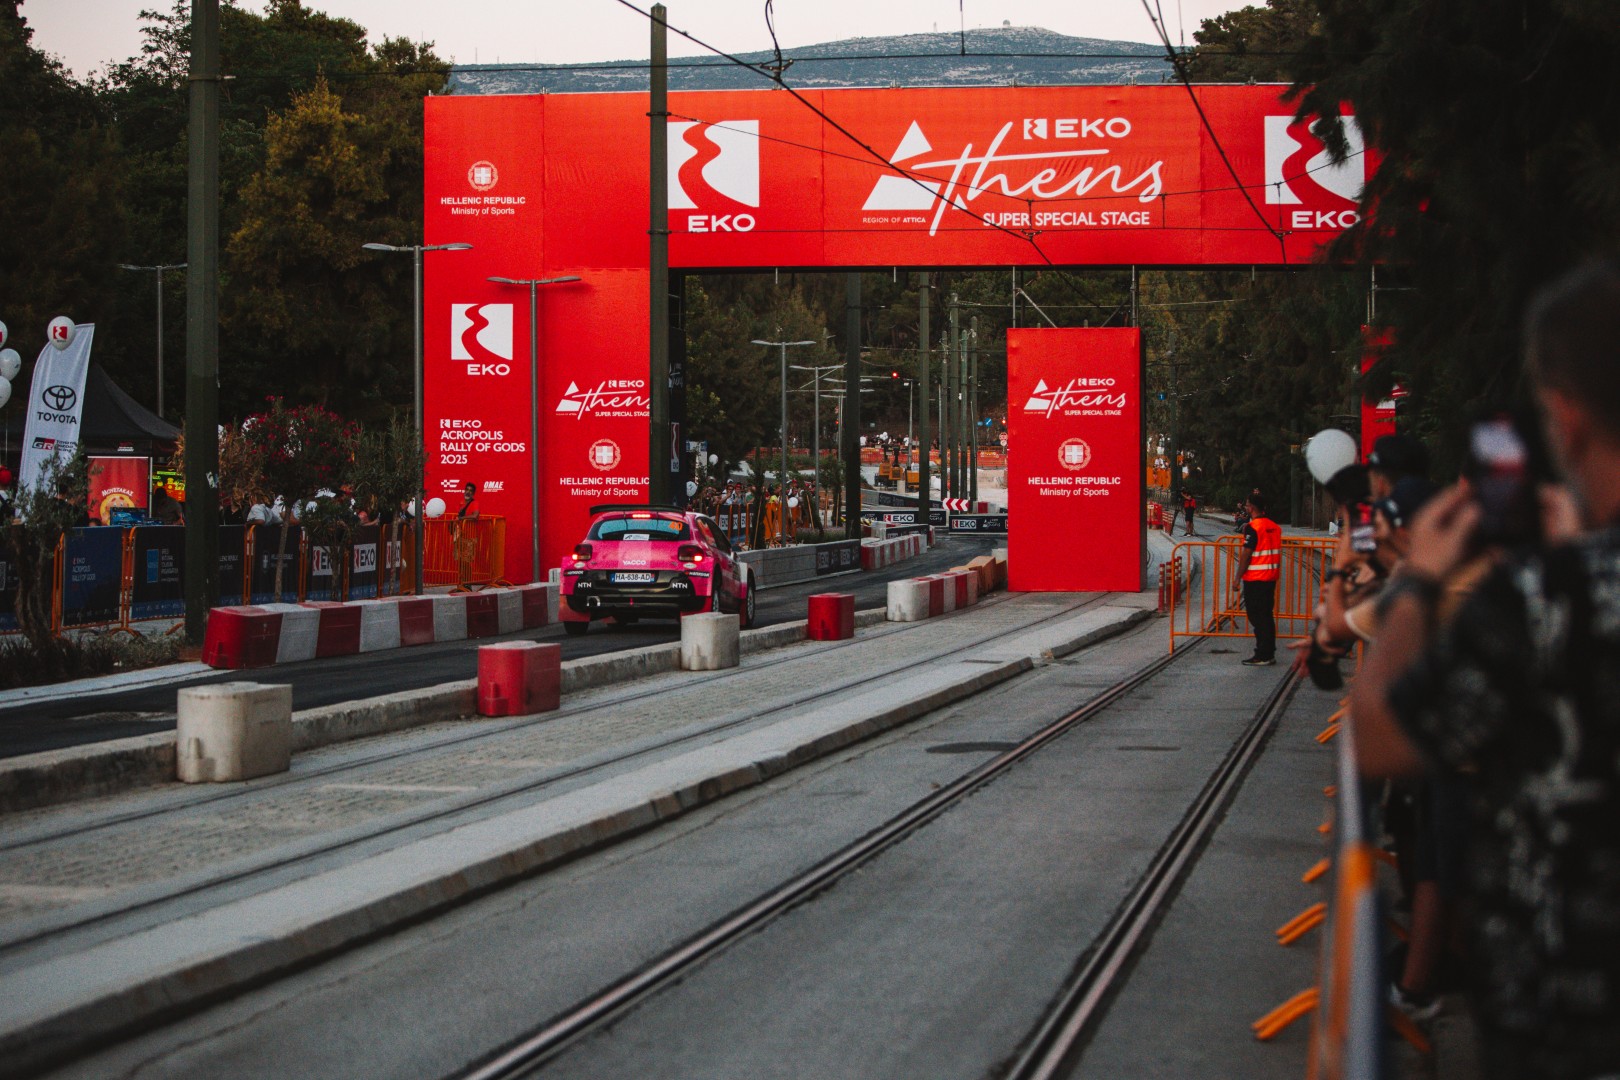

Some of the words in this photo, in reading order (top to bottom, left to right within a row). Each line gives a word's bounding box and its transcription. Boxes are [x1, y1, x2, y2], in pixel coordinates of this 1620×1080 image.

[1055, 118, 1131, 138] EKO
[441, 197, 482, 205] HELLENIC
[483, 196, 526, 204] REPUBLIC
[451, 207, 480, 216] Ministry
[490, 207, 515, 216] Sports
[688, 213, 756, 232] EKO
[982, 212, 1030, 227] SUPER
[1034, 211, 1097, 226] SPECIAL
[1100, 211, 1150, 226] STAGE
[1292, 210, 1361, 228] EKO
[467, 363, 510, 376] EKO
[618, 380, 645, 388] EKO
[1088, 378, 1116, 386] EKO
[37, 411, 77, 425] TOYOTA
[452, 420, 482, 428] EKO
[440, 430, 503, 440] ACROPOLIS
[440, 442, 473, 452] RALLY
[475, 442, 491, 452] OF
[493, 442, 525, 452] GODS
[440, 454, 468, 465] 2025
[483, 481, 504, 489] OMAE
[560, 477, 603, 485] HELLENIC
[605, 477, 650, 485] REPUBLIC
[1028, 477, 1073, 485] HELLENIC
[1075, 477, 1121, 485] REPUBLIC
[571, 488, 602, 498] Ministry
[603, 488, 611, 496] of
[613, 488, 639, 497] Sports
[1039, 488, 1071, 497] Ministry
[1073, 488, 1081, 496] of
[1083, 488, 1109, 497] Sports
[892, 514, 914, 522] EKO
[959, 520, 976, 528] EKO
[360, 548, 376, 567] EKO
